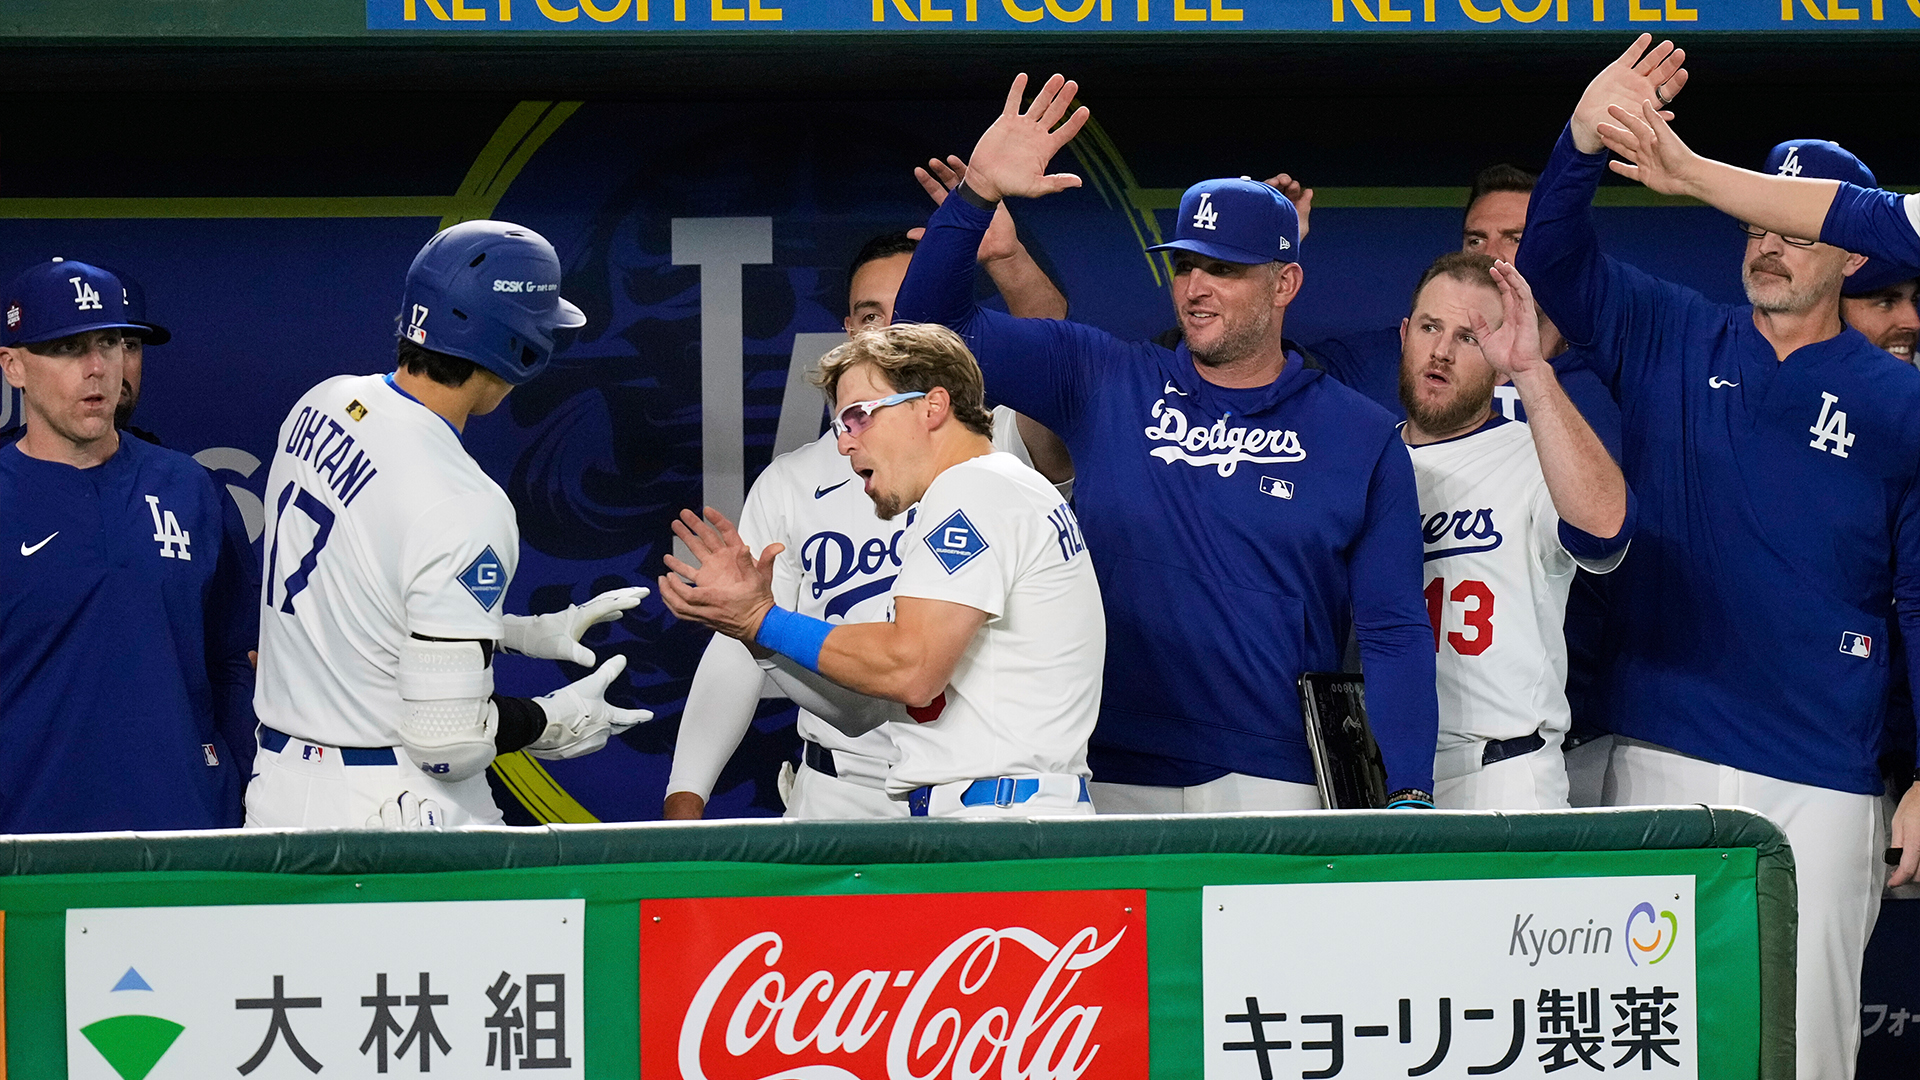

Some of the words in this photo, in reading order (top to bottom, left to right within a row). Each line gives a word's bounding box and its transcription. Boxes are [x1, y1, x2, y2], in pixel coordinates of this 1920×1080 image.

[1777, 146, 1803, 177] LA
[1193, 193, 1218, 230] LA
[69, 277, 103, 310] LA
[411, 303, 429, 327] 17
[493, 279, 524, 292] SCSK
[285, 406, 378, 508] OHTANI
[1145, 399, 1307, 477] Dodgers
[1809, 391, 1856, 459] LA
[145, 495, 191, 561] LA
[266, 480, 336, 615] 17
[944, 527, 969, 549] G
[478, 563, 497, 584] G
[1424, 577, 1495, 656] 13
[1509, 913, 1613, 967] Kyorin
[235, 971, 572, 1076] 大林組
[678, 926, 1127, 1080] Coca-Cola
[1222, 986, 1681, 1080] キョーリン製薬
